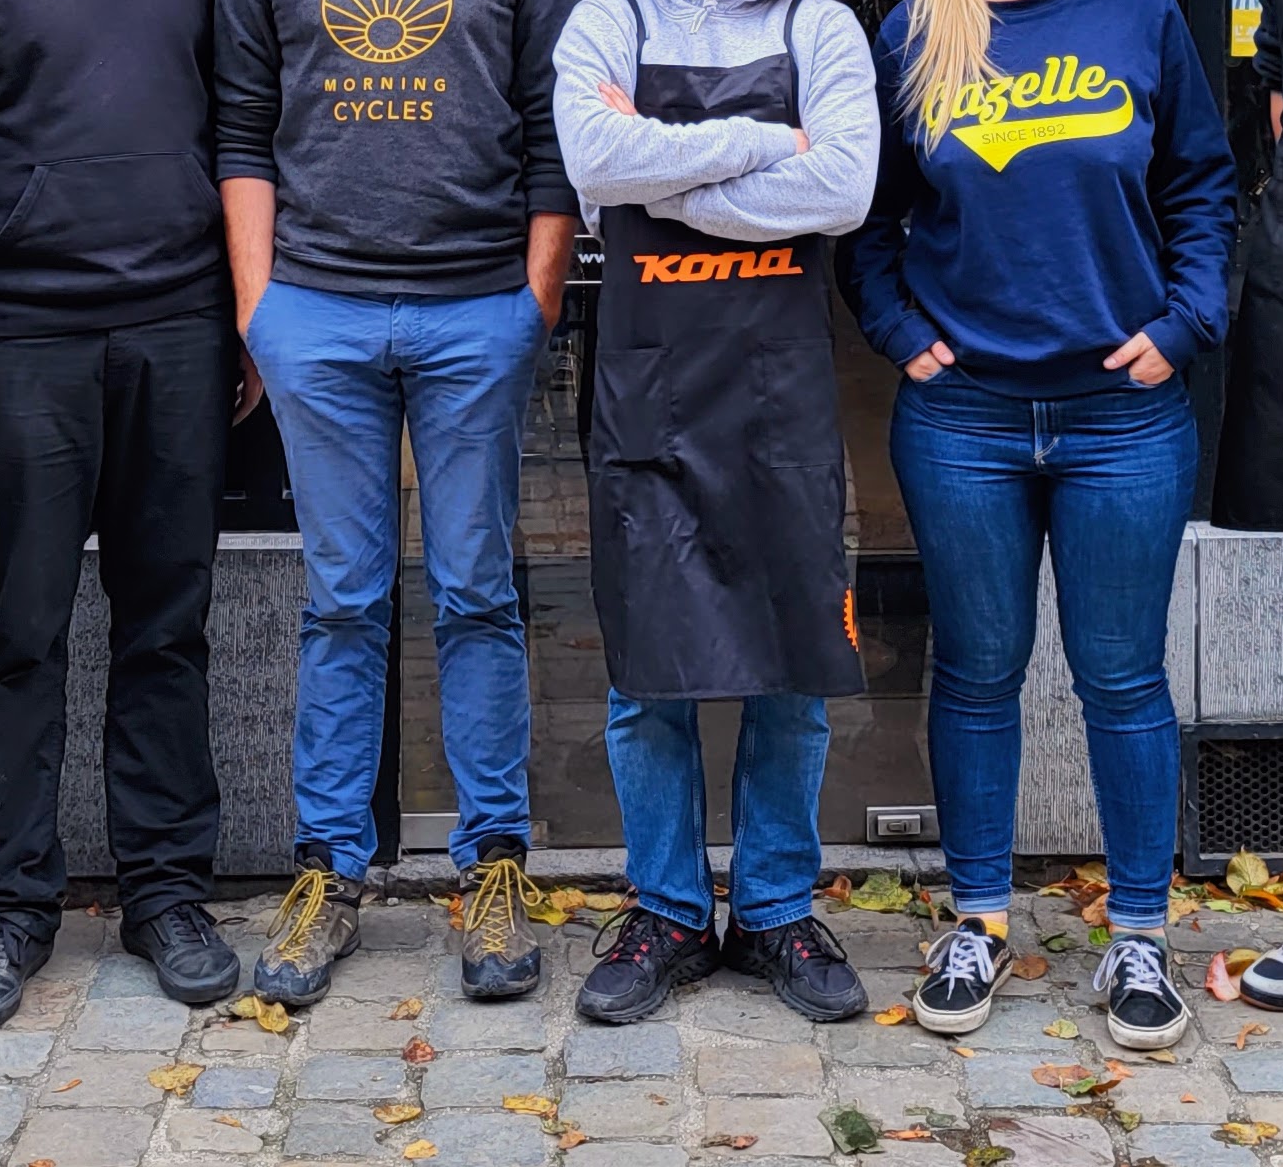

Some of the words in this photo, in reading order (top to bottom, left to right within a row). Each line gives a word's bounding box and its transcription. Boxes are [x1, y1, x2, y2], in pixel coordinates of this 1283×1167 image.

[324, 77, 446, 92] MORNING
[333, 100, 434, 121] CYCLES
[981, 129, 1027, 144] SINCE
[1032, 123, 1066, 139] 1892
